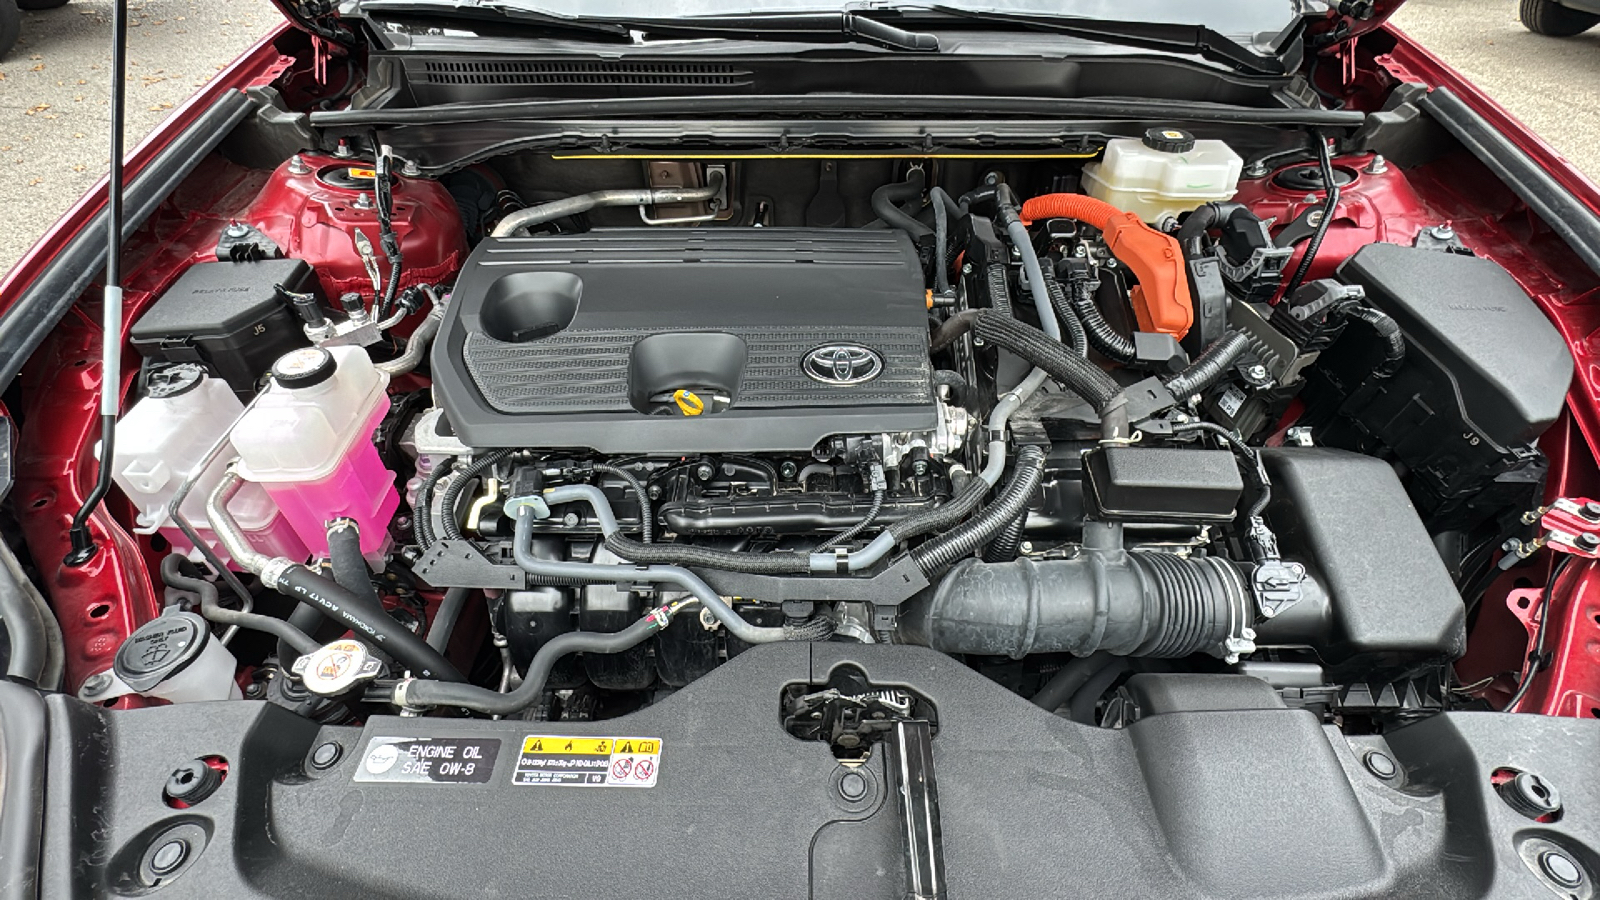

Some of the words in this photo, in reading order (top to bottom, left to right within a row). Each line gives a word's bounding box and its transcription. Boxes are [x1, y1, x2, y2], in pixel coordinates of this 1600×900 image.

[253, 323, 266, 336] J5
[1462, 432, 1480, 446] J9
[308, 592, 339, 612] ACV17
[342, 610, 377, 636] YOKOHAMA
[166, 626, 188, 636] FLUID
[406, 744, 458, 759] ENGINE
[462, 745, 483, 759] OIL
[401, 761, 433, 774] SAE
[439, 761, 476, 776] 0W-8
